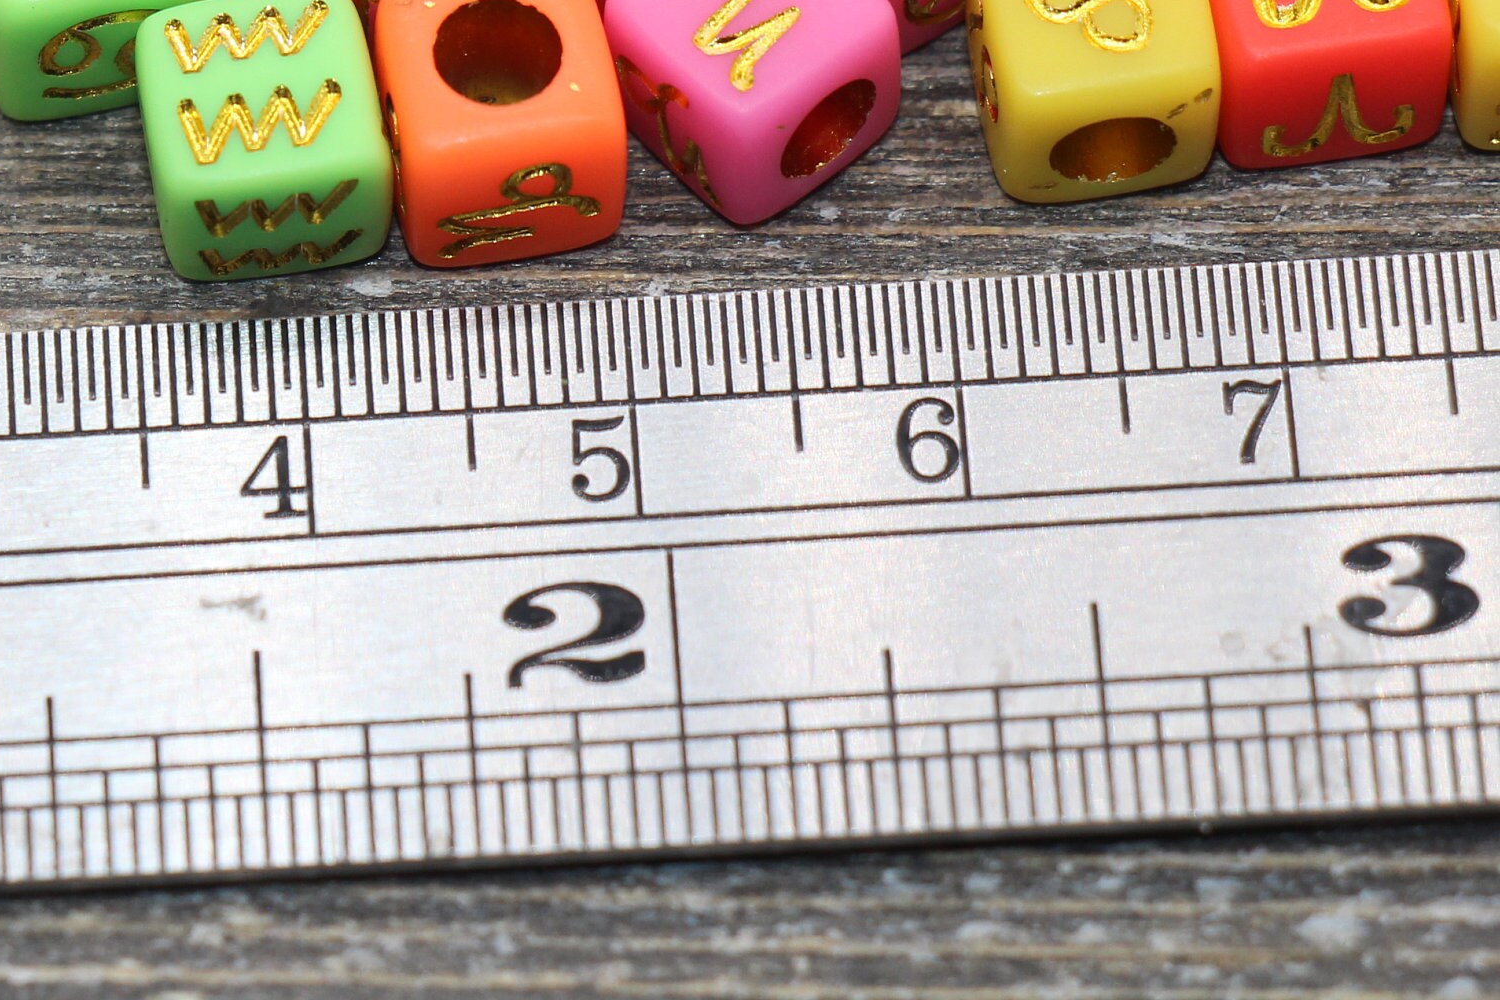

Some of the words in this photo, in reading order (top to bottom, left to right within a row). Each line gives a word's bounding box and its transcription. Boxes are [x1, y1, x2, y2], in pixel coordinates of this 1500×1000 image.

[239, 435, 307, 520] 4
[570, 415, 631, 502] 5
[897, 397, 960, 483] 6
[1221, 379, 1282, 464] 7
[501, 580, 647, 688] 2
[1338, 533, 1481, 637] 3
